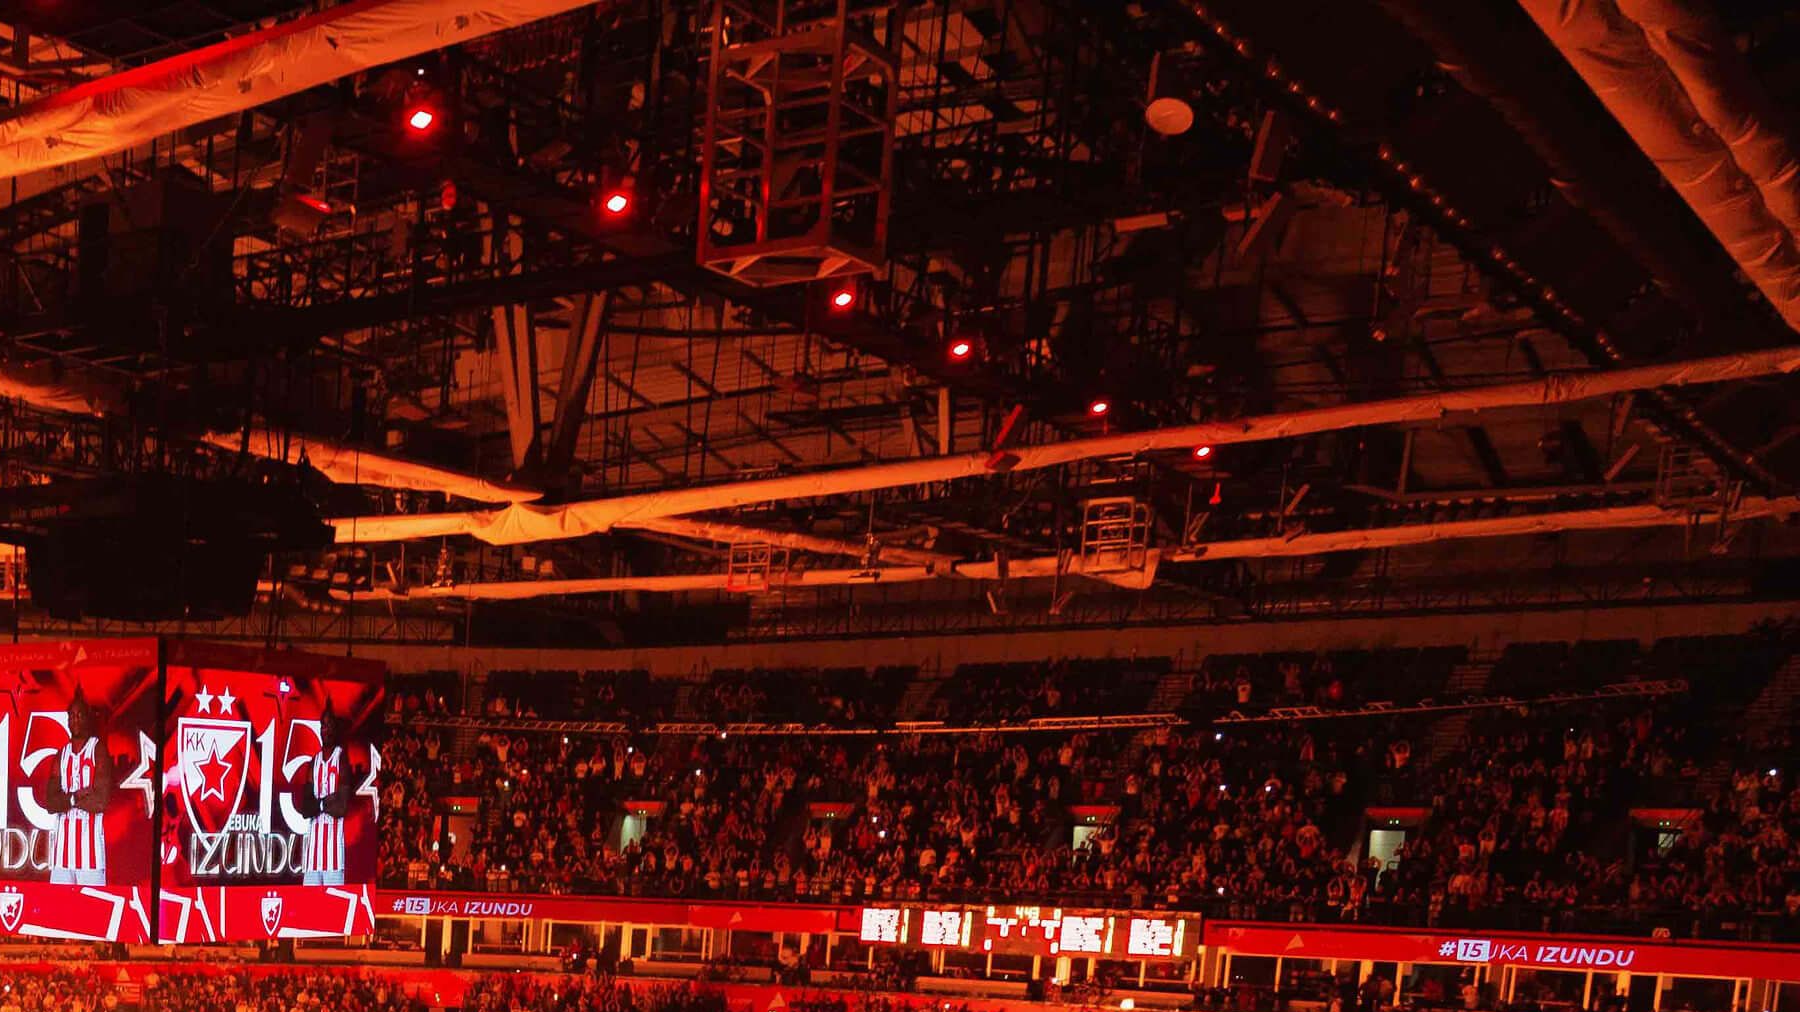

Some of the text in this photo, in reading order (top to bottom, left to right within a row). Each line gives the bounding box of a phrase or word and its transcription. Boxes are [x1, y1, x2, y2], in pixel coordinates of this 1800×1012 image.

[186, 731, 206, 752] KK
[190, 832, 309, 875] IZUNDU
[463, 901, 534, 917] IZUNDU
[1535, 945, 1635, 967] IZUNDU
